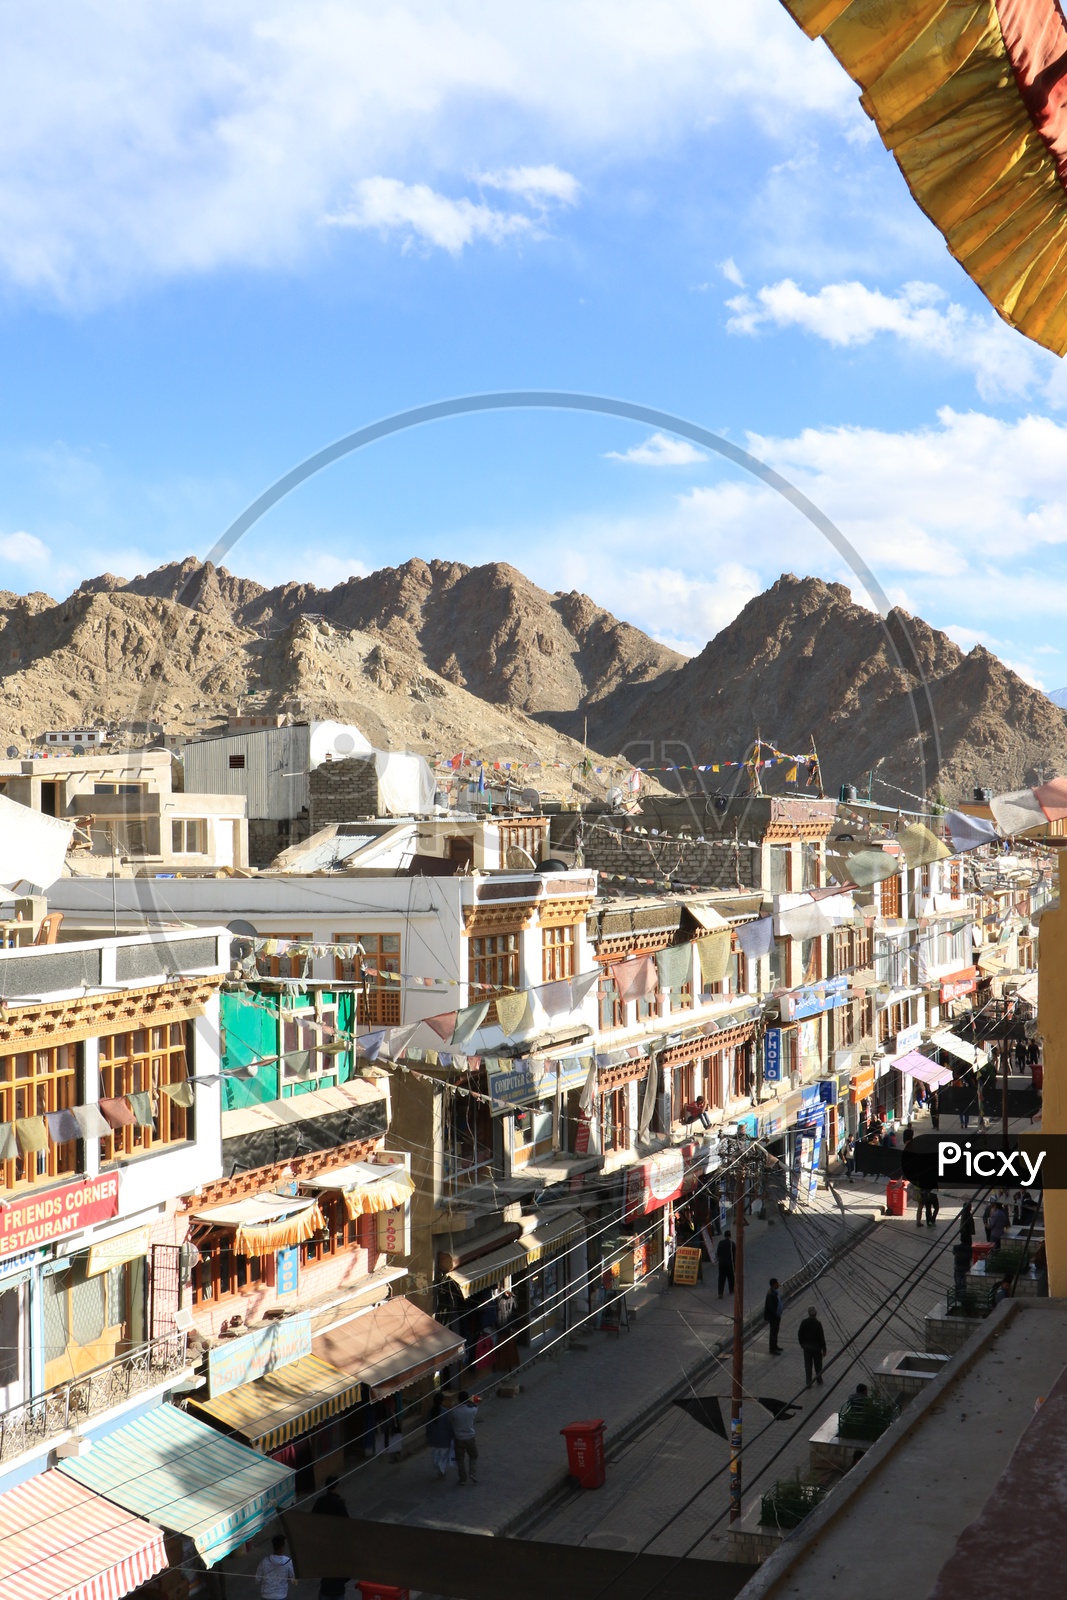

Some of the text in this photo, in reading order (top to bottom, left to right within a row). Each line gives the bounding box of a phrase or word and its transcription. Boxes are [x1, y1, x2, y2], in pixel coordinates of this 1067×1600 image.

[767, 1031, 777, 1078] PHOTO
[494, 1073, 525, 1094] COMPUTER
[4, 1179, 117, 1232] FRIENDS CORNER
[386, 1218, 396, 1250] FOOD
[0, 1249, 36, 1273] DICOS
[282, 1251, 293, 1292] FOOD
[213, 1363, 247, 1389] CLOTH
[250, 1335, 309, 1371] MERCHANTS
